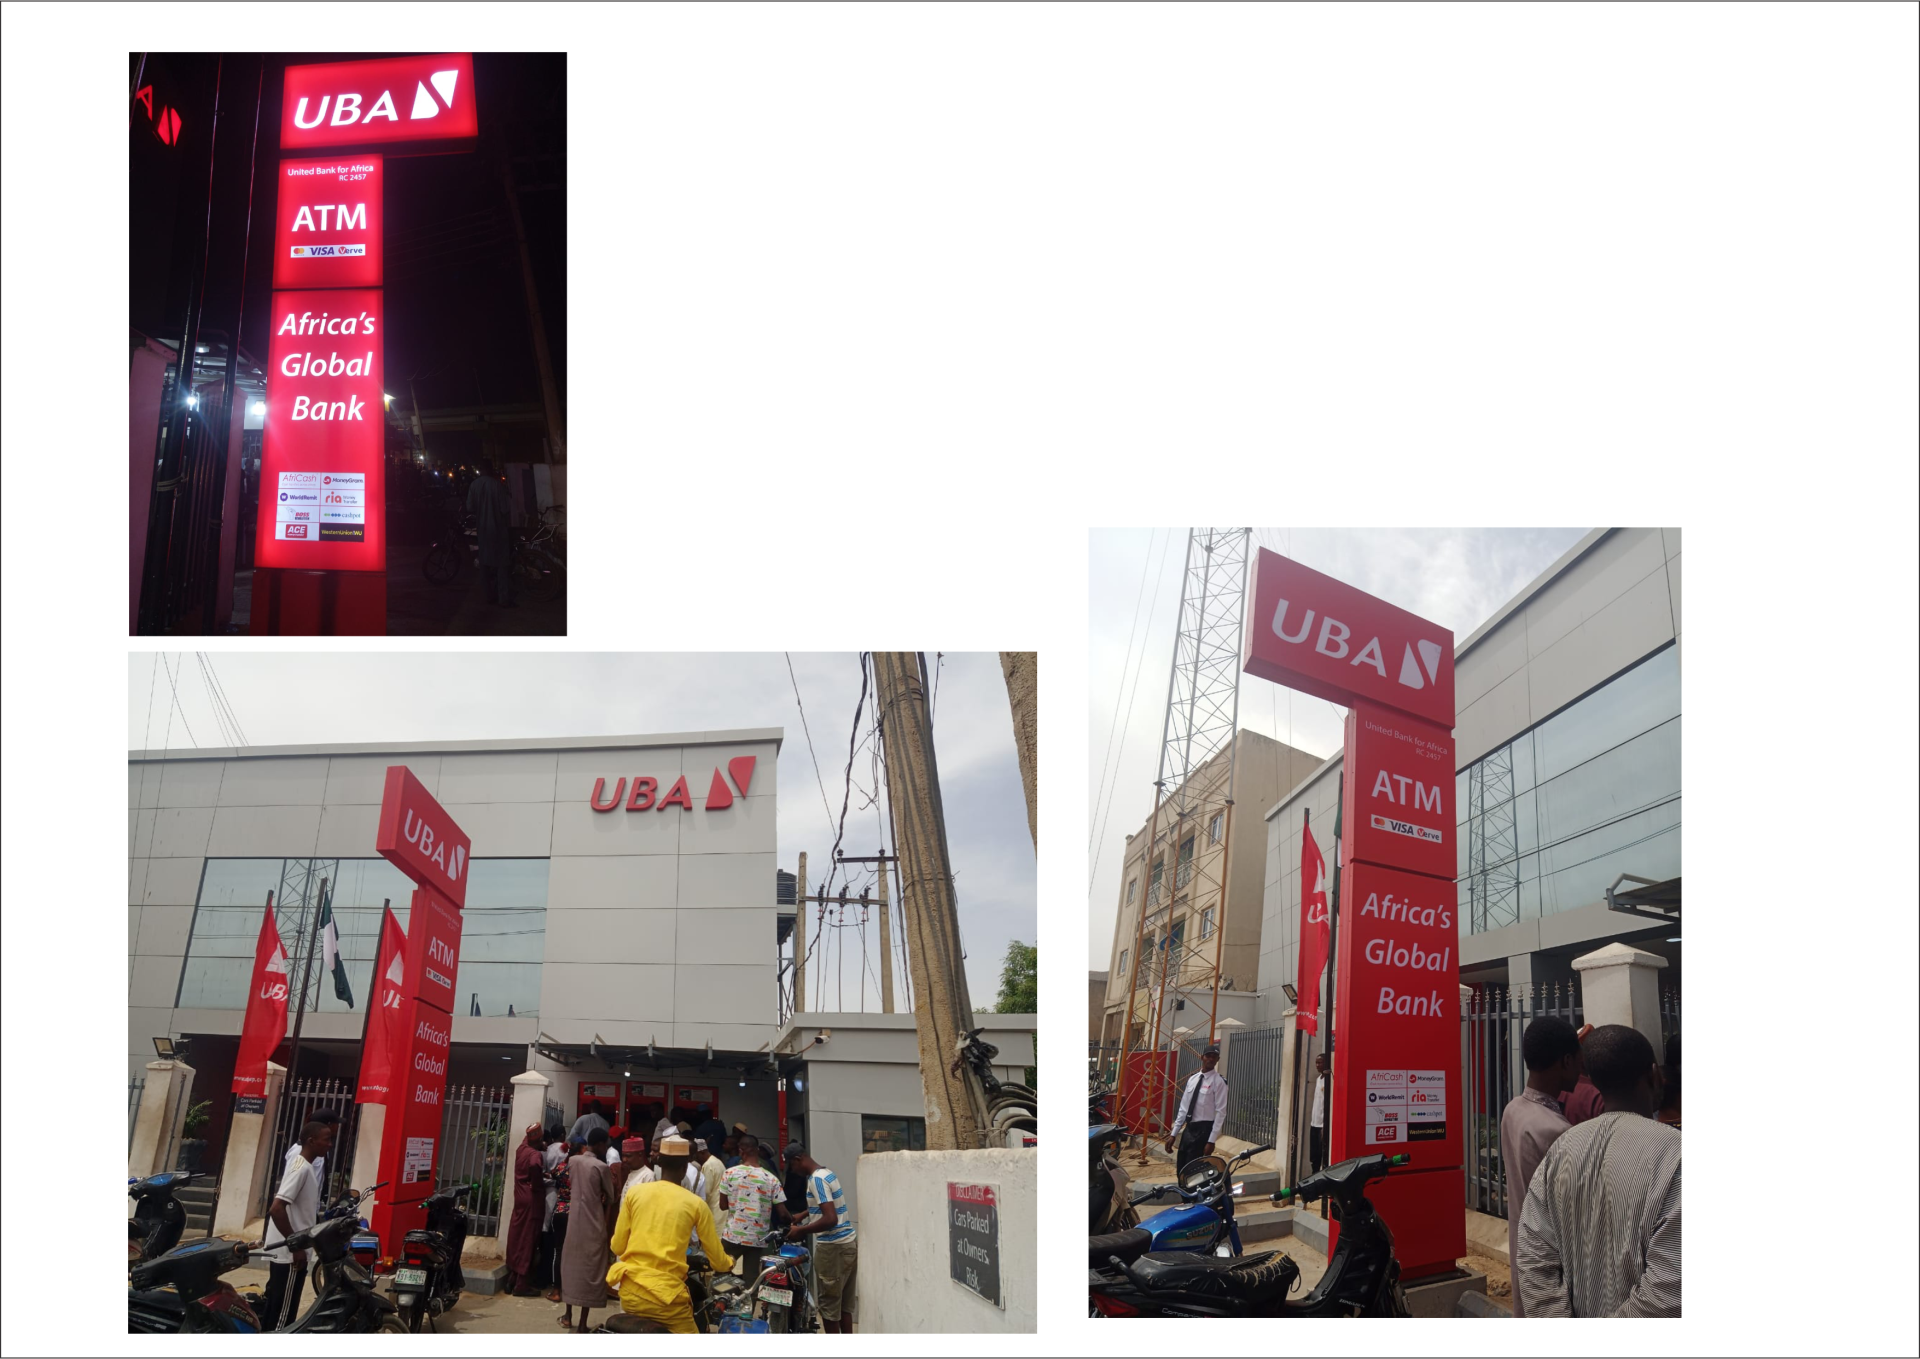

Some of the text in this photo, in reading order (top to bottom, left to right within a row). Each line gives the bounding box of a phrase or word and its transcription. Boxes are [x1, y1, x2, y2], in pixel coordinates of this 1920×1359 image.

[294, 90, 399, 129] UBA
[287, 168, 314, 176] United
[350, 165, 374, 173] Africa
[291, 203, 366, 232] ATM
[310, 247, 334, 255] VISA
[338, 246, 363, 255] Verve
[277, 312, 375, 335] Africa's
[281, 351, 373, 377] Global
[291, 394, 365, 421] Bank
[282, 474, 317, 483] AfriCash
[325, 491, 342, 503] ria
[1272, 598, 1387, 678] UBA
[1365, 720, 1448, 755] United Bank for Africa
[1416, 747, 1441, 761] RC 2457
[590, 775, 693, 813] UBA
[1371, 769, 1442, 815] ATM
[404, 808, 444, 871] UBA
[1389, 820, 1414, 835] VISA
[1417, 828, 1440, 841] Verve
[1360, 892, 1451, 929] Africa's
[428, 936, 454, 969] ATM
[1365, 938, 1450, 972] Global
[1377, 987, 1444, 1018] Bank
[416, 1021, 448, 1047] Africa's
[414, 1052, 445, 1075] Global
[1371, 1072, 1403, 1081] AfriCash
[415, 1084, 439, 1105] Bank
[1411, 1090, 1426, 1102] ria
[1378, 1127, 1395, 1136] ACE
[954, 1209, 989, 1234] Cars Parked
[957, 1238, 963, 1254] at
